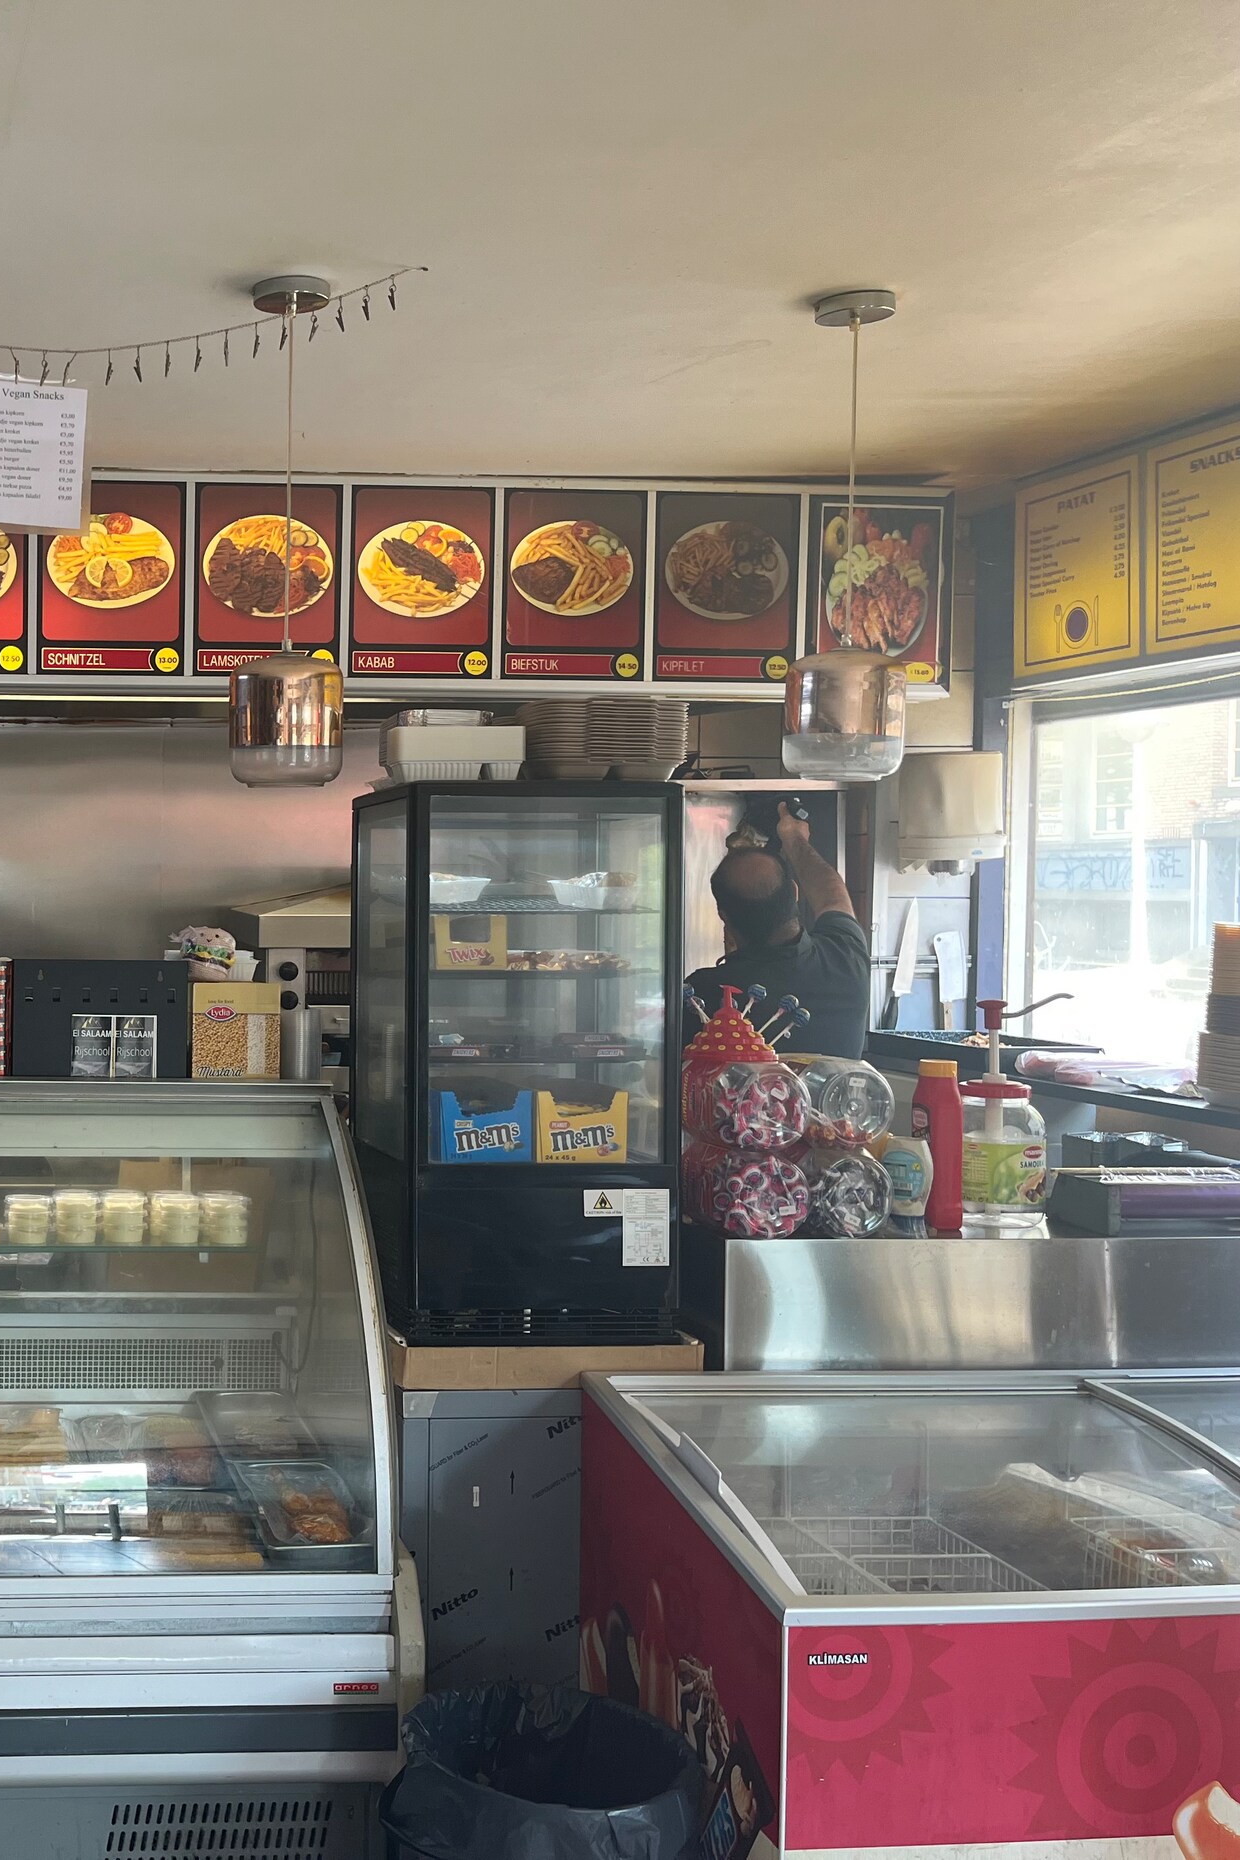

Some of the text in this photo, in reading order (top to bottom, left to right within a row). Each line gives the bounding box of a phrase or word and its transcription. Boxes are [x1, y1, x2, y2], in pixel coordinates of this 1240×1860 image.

[2, 388, 64, 401] Vegan Snacks
[1190, 446, 1240, 473] SNACKS
[1057, 491, 1097, 514] PATAT
[47, 653, 106, 666] SCHNITZEL
[358, 656, 396, 669] KABAB
[511, 658, 560, 671] BIEFSTUK
[662, 660, 704, 673] KIPFILET
[444, 945, 487, 964] Twix
[210, 1008, 231, 1018] Lydia
[81, 1029, 112, 1038] SALAAM
[123, 1030, 154, 1039] SALAAM
[74, 1045, 111, 1059] Rijschool
[116, 1046, 153, 1060] Rijschool
[196, 1066, 244, 1079] Mustard
[546, 1415, 583, 1440] Nit
[429, 1457, 448, 1472] GUARD
[431, 1587, 480, 1621] Nitto
[544, 1614, 582, 1643] Nitt
